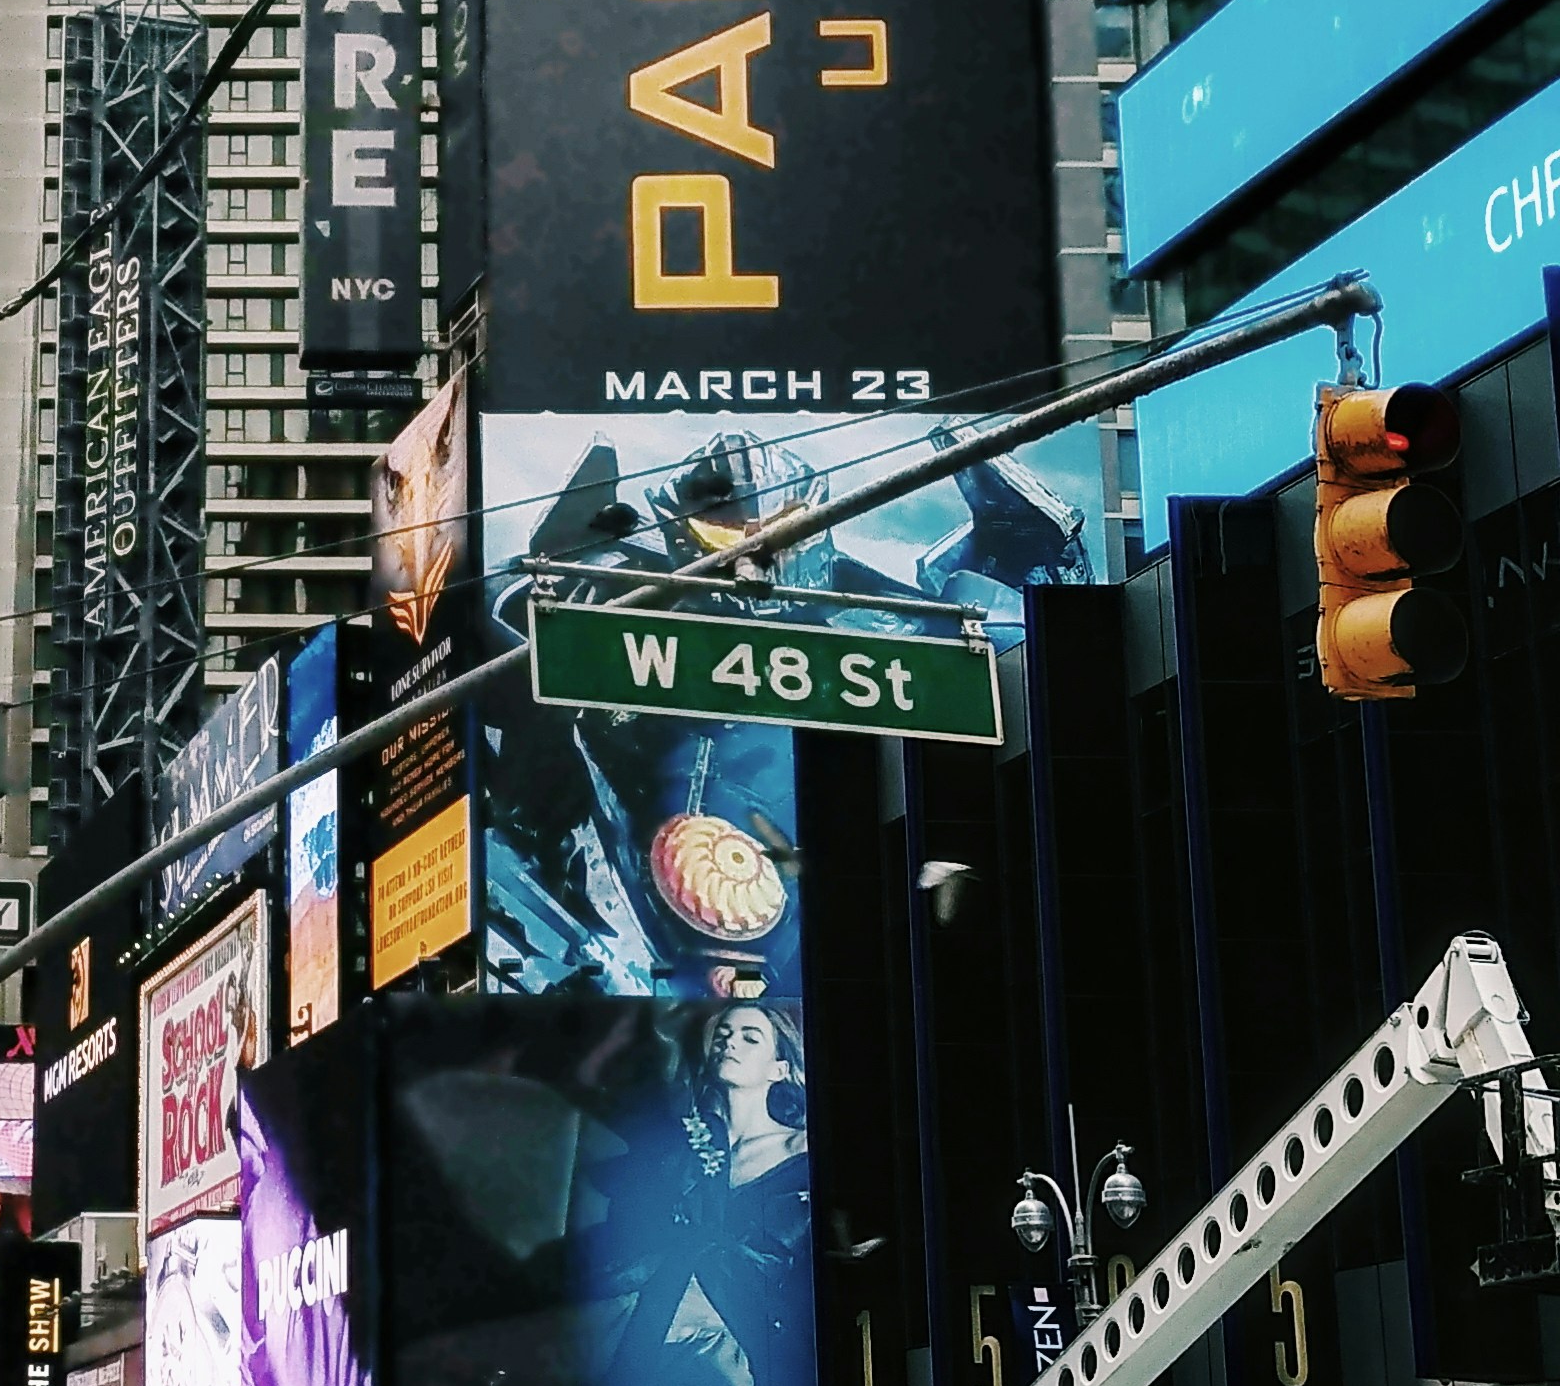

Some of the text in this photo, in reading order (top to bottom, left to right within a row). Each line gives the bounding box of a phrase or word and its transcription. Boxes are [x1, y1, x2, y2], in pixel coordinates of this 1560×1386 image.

[330, 276, 396, 302] NYC
[111, 256, 140, 558] OUTFITTERS
[603, 368, 932, 402] MARCH 23
[83, 377, 109, 629] AMERICAN
[622, 632, 914, 711] W 48 St
[43, 1055, 68, 1104] MGM
[68, 1016, 117, 1086] RESORTS
[162, 981, 228, 1088] SCHOOL
[160, 1057, 227, 1189] ROCK
[29, 1279, 52, 1352] SHOW
[256, 1226, 348, 1320] PUCCINI
